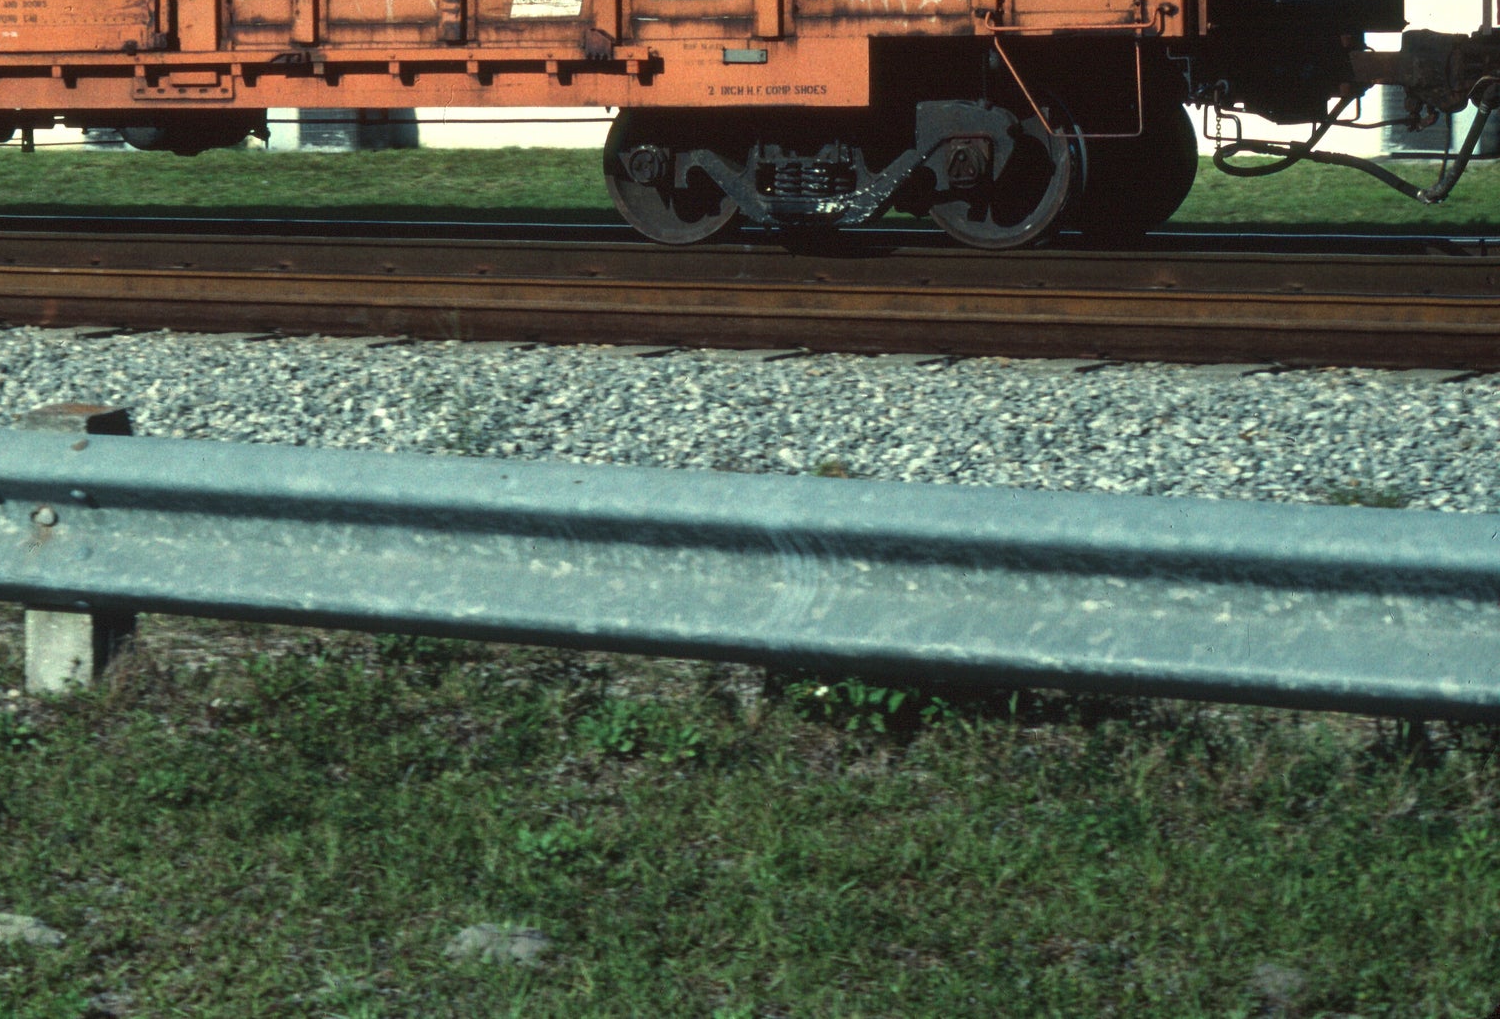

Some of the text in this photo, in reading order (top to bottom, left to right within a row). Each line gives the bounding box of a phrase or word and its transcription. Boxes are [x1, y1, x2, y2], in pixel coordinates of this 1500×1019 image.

[708, 86, 714, 96] 2
[721, 85, 744, 96] INCH
[765, 85, 791, 95] COMP
[794, 84, 827, 95] SHOES
